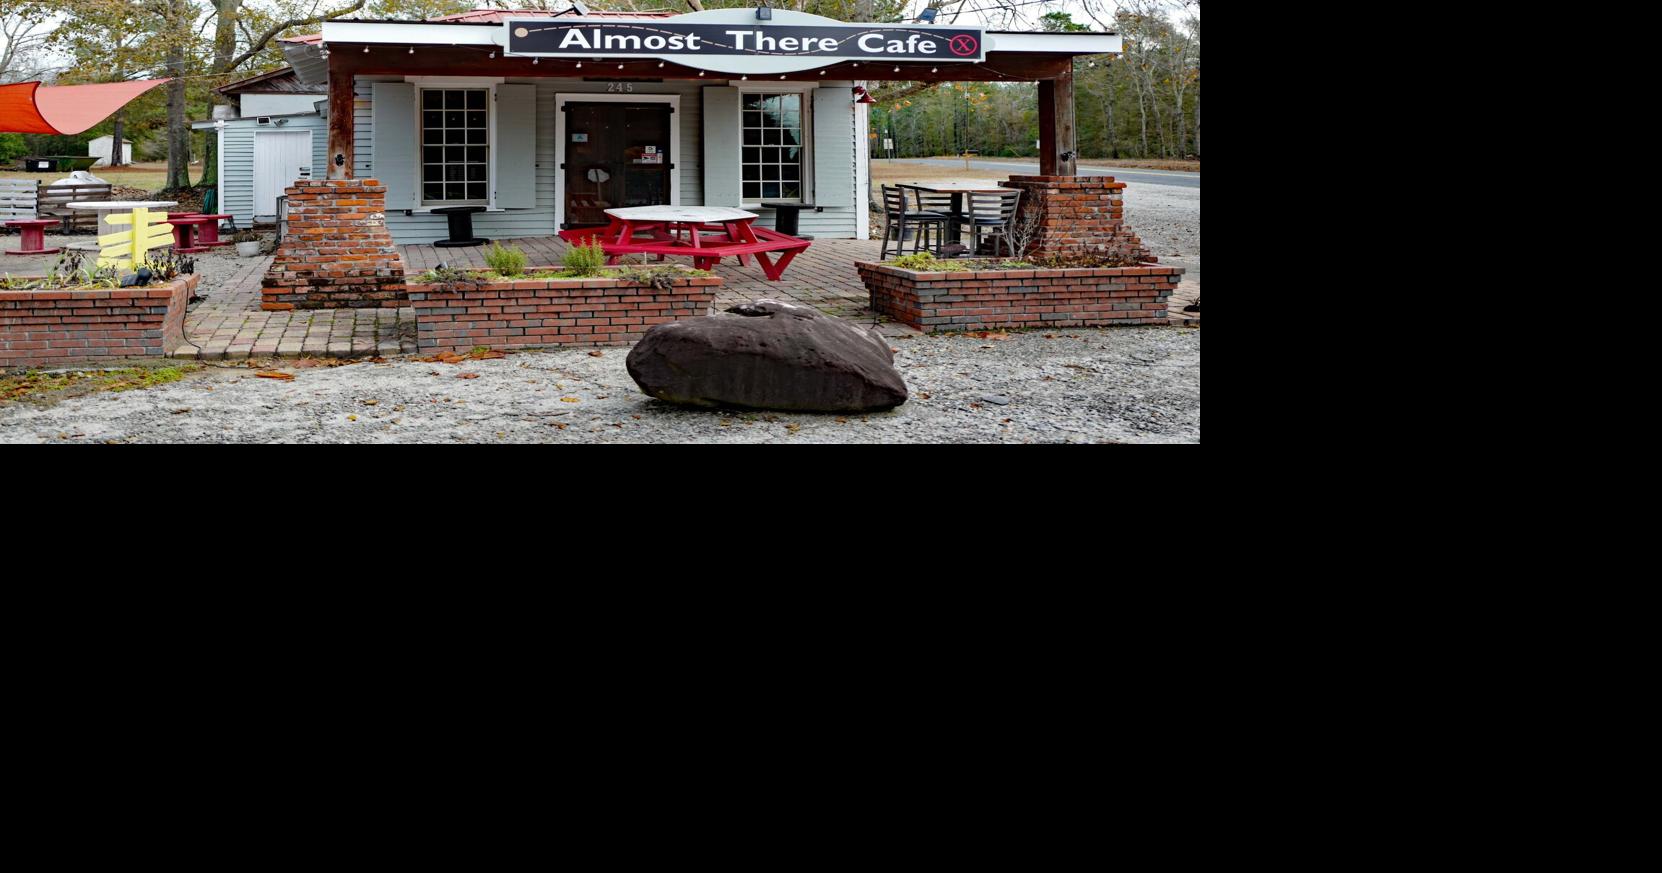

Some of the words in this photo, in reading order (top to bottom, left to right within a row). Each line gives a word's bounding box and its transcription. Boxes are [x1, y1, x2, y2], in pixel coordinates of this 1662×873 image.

[559, 28, 701, 51] Almost
[726, 30, 838, 53] There
[857, 33, 937, 54] Cafe
[607, 82, 633, 92] 245
